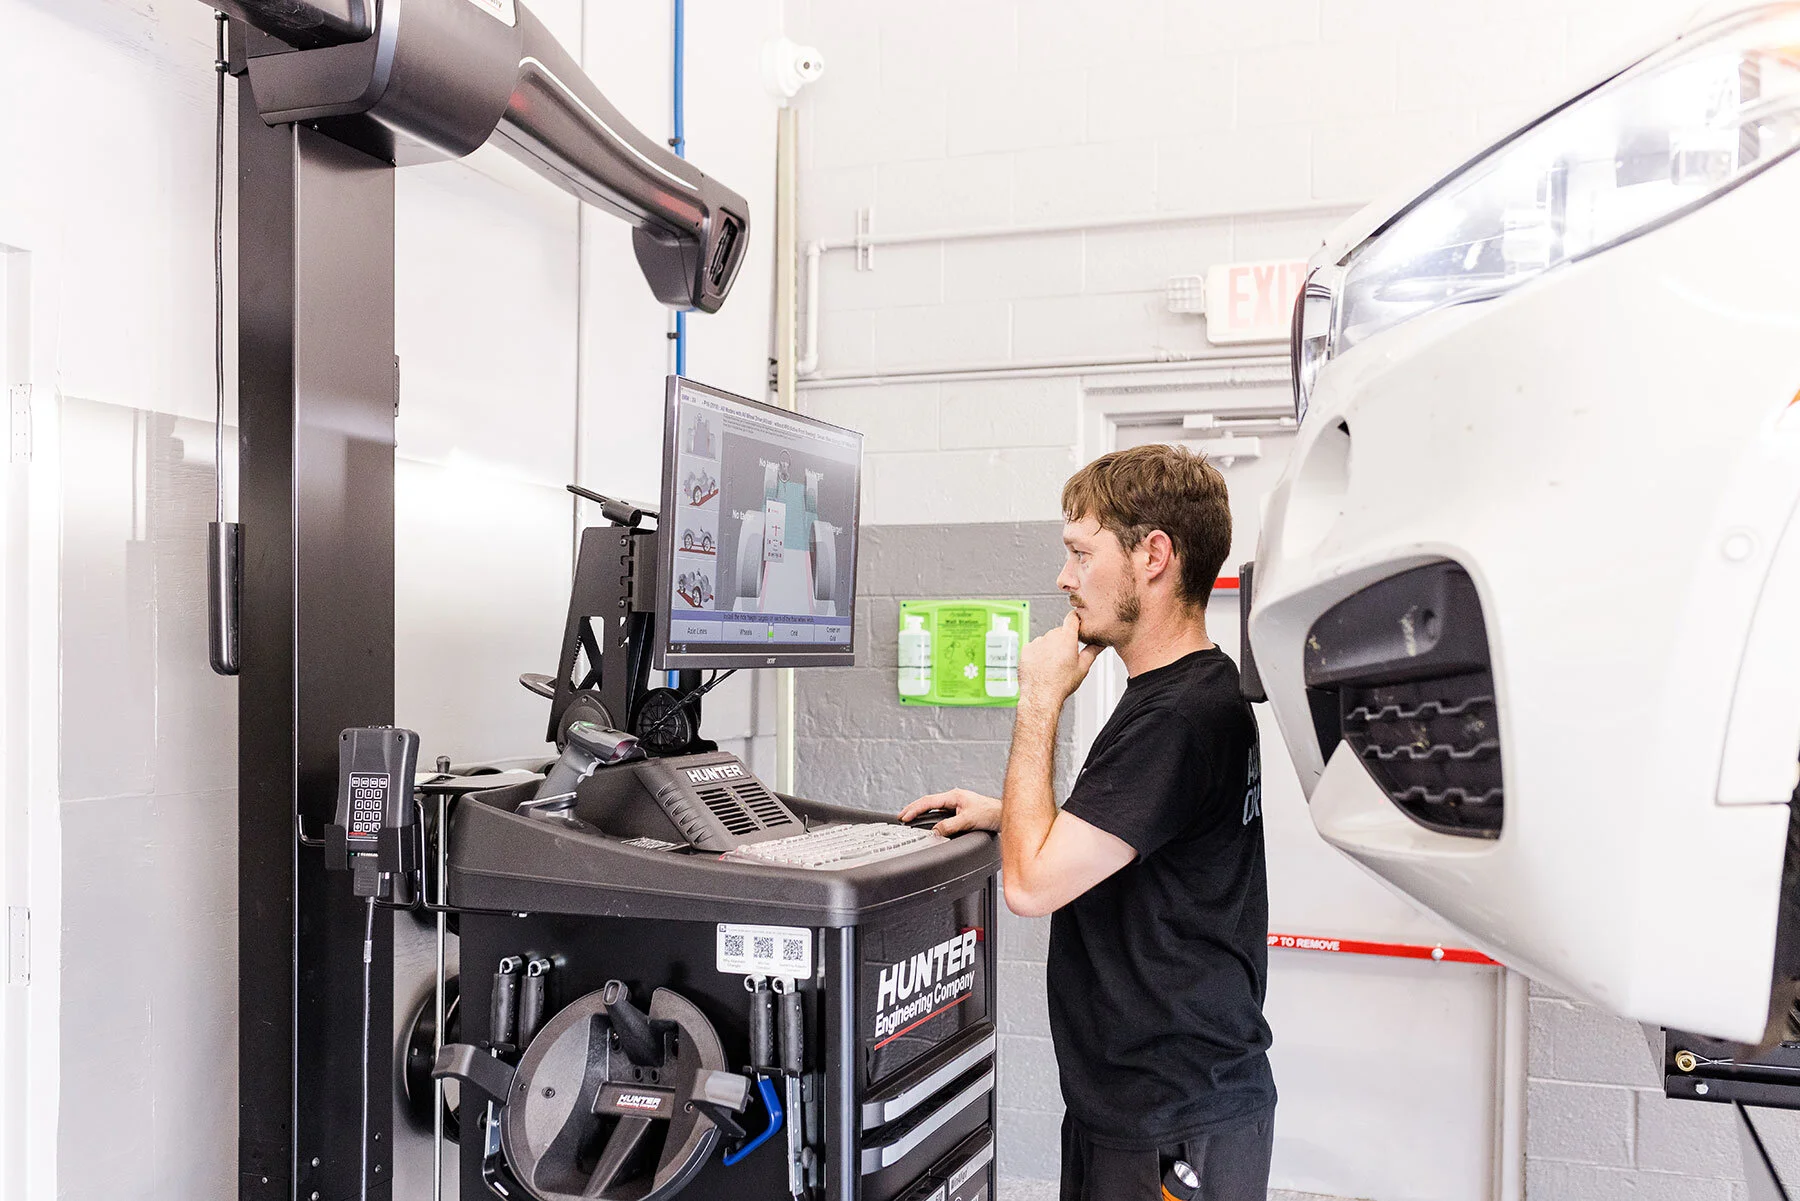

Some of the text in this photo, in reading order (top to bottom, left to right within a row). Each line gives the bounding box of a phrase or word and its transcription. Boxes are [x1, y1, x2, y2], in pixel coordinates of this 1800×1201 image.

[1228, 262, 1308, 329] EXIT
[766, 657, 777, 665] acer
[686, 764, 743, 783] HUNTER
[1280, 936, 1295, 947] TO
[1296, 938, 1340, 951] REMOVE
[877, 929, 977, 1013] HUNTER
[874, 970, 976, 1038] Engineering Company
[618, 1094, 662, 1105] HUNTER
